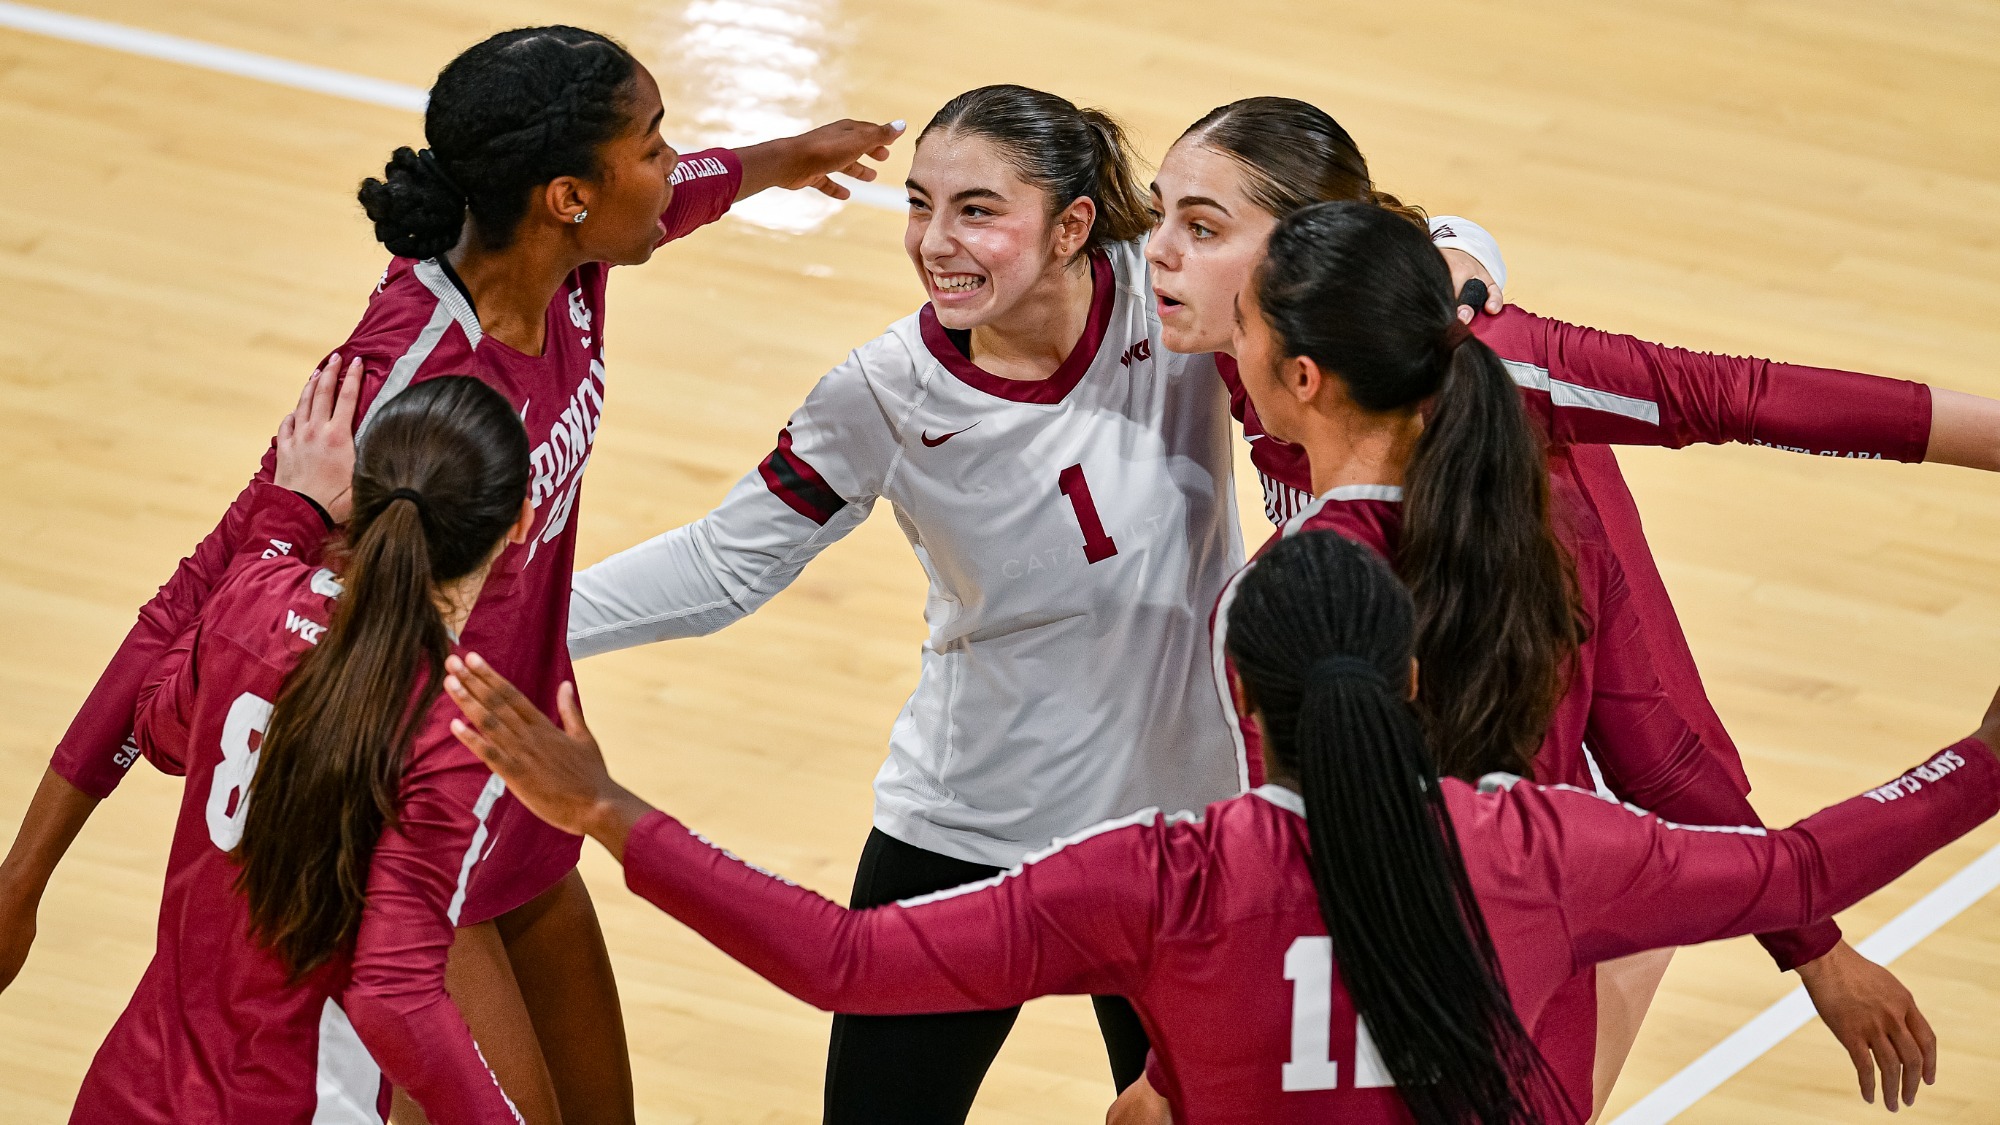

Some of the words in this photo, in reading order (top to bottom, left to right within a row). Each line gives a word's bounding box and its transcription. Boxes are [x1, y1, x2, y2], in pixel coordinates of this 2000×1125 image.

[667, 161, 697, 186] ANTA
[687, 156, 729, 178] CLARA
[1058, 462, 1119, 565] 1
[205, 691, 275, 853] 8
